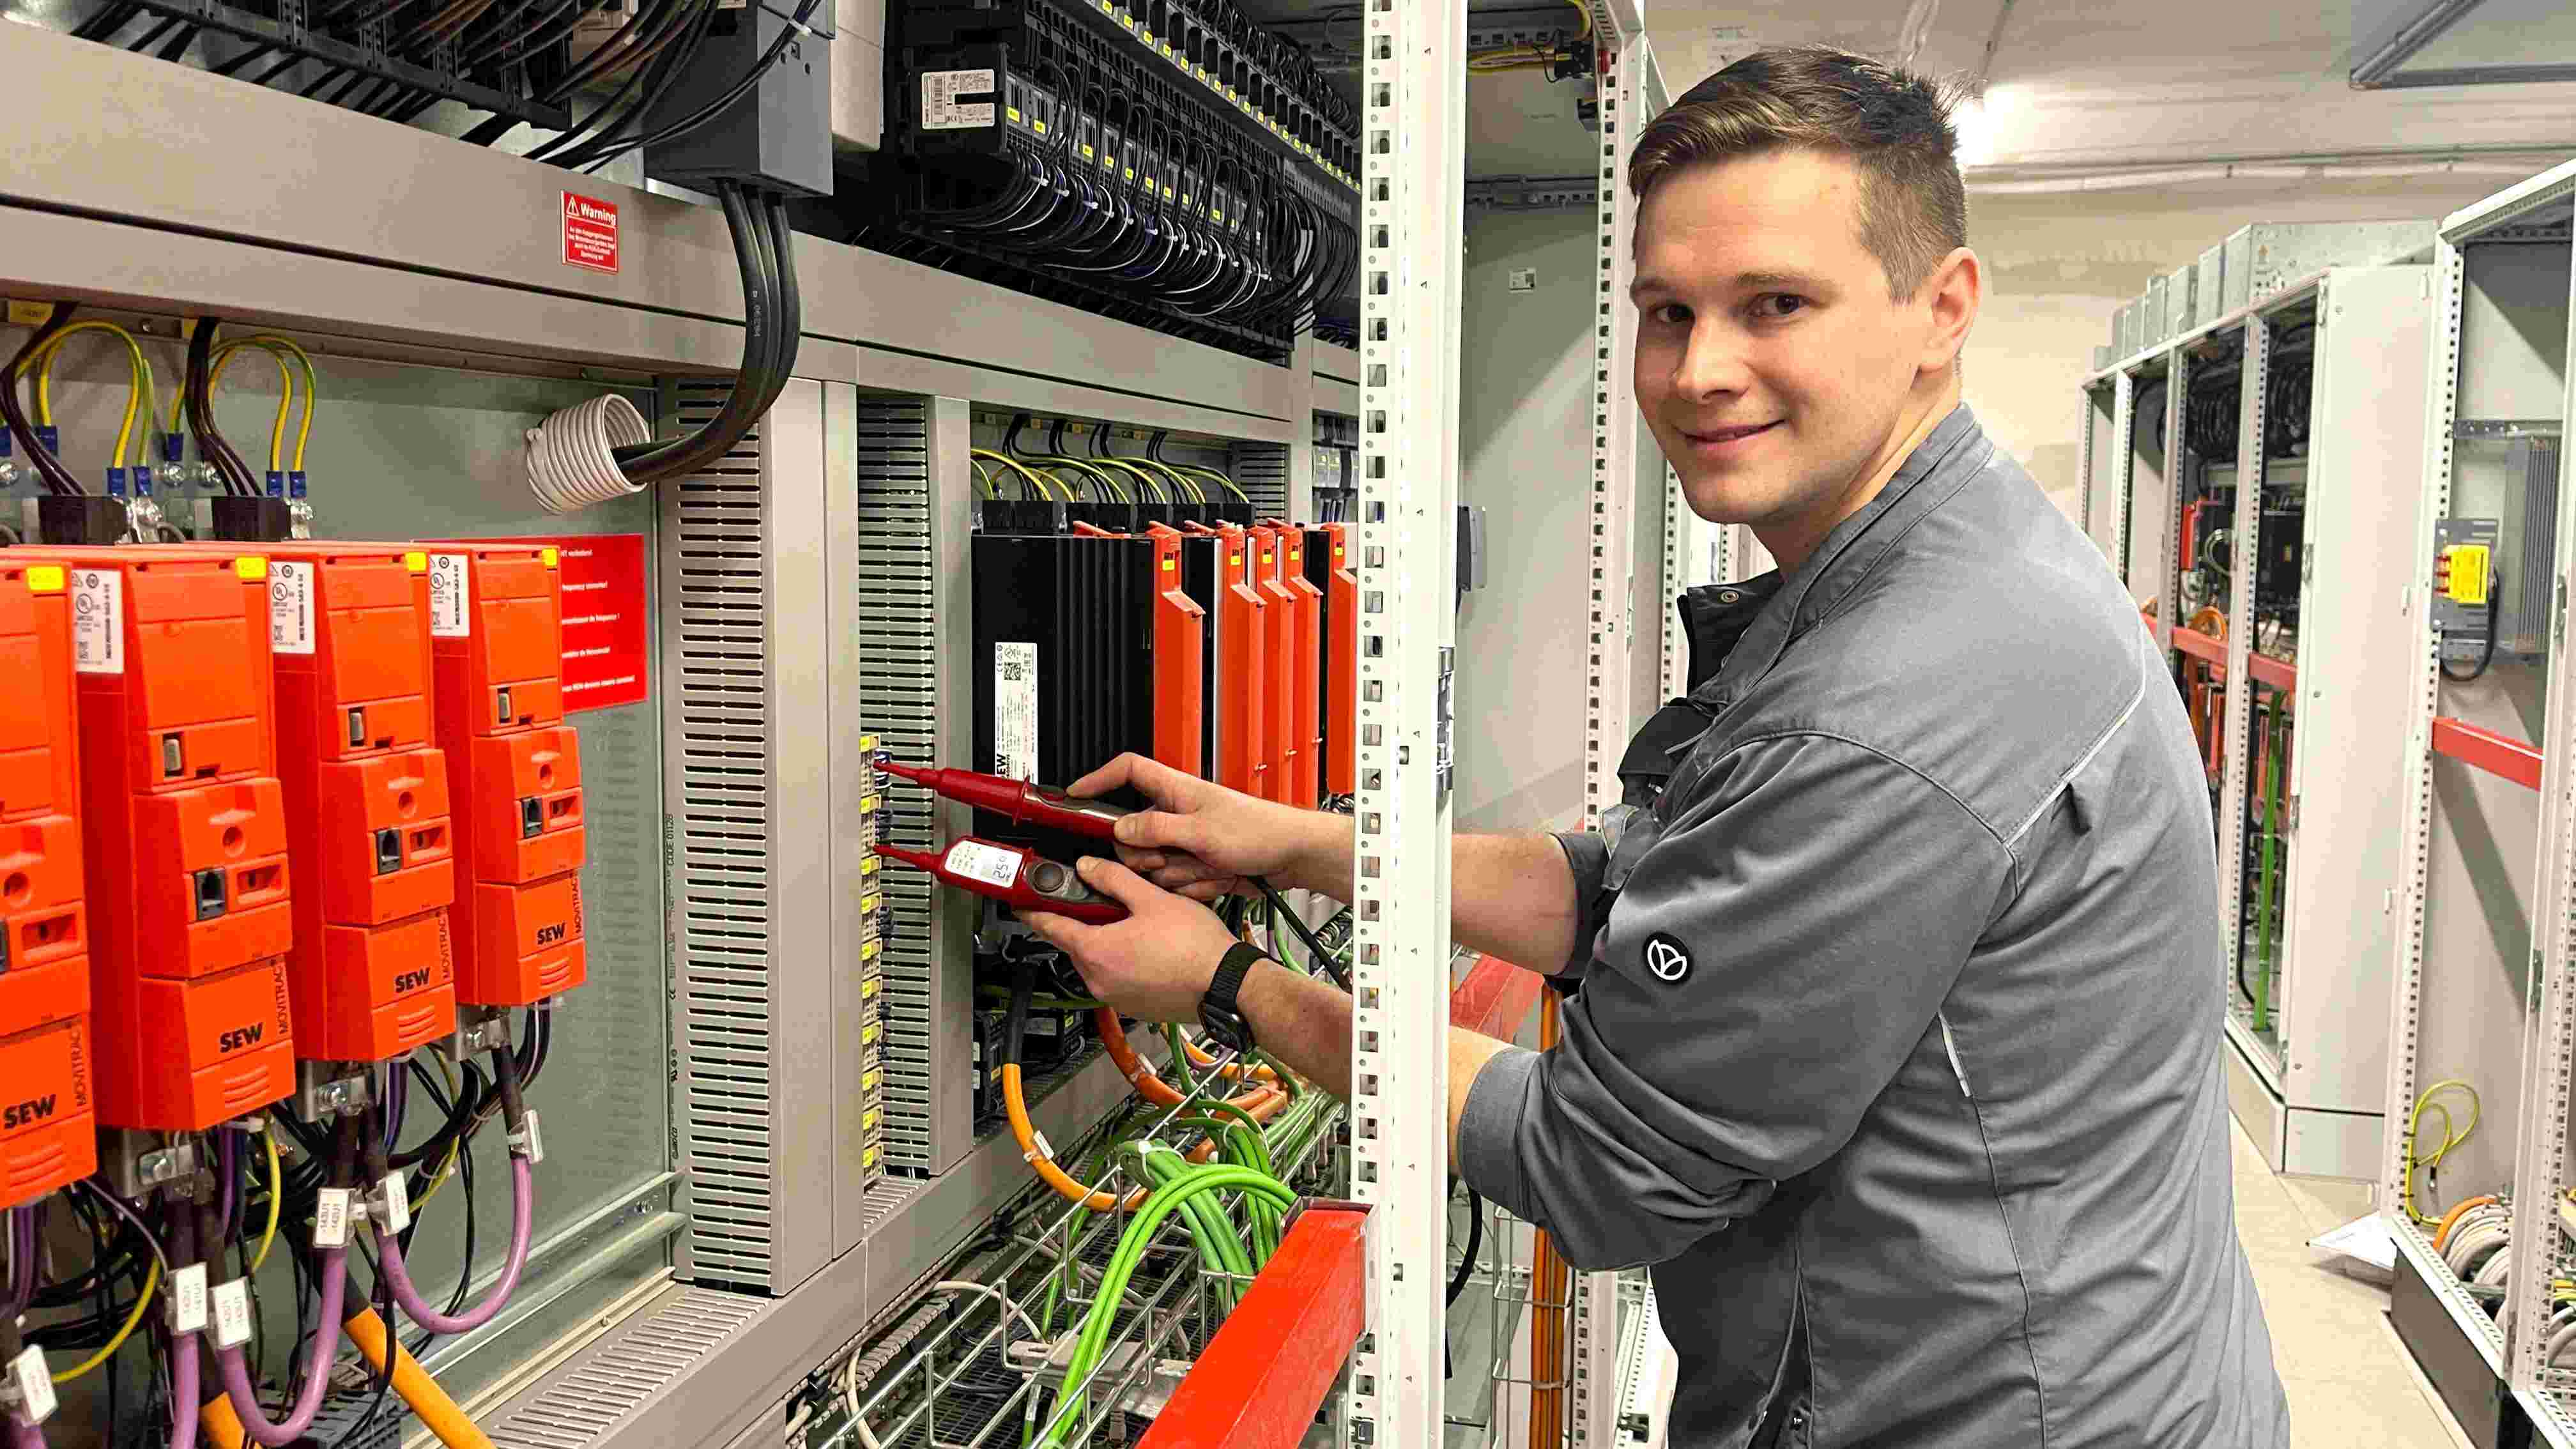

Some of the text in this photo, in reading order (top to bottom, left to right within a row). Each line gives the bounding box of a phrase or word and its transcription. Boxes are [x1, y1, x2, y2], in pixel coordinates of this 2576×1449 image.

[580, 203, 616, 226] Warning
[997, 753, 1006, 778] EW
[438, 910, 451, 981] MOVITRAC
[537, 921, 565, 945] SEW
[395, 967, 431, 993] SEW
[273, 963, 289, 1035] MOVITRAC
[219, 1022, 263, 1053] SEW
[4, 1093, 56, 1130] SEW
